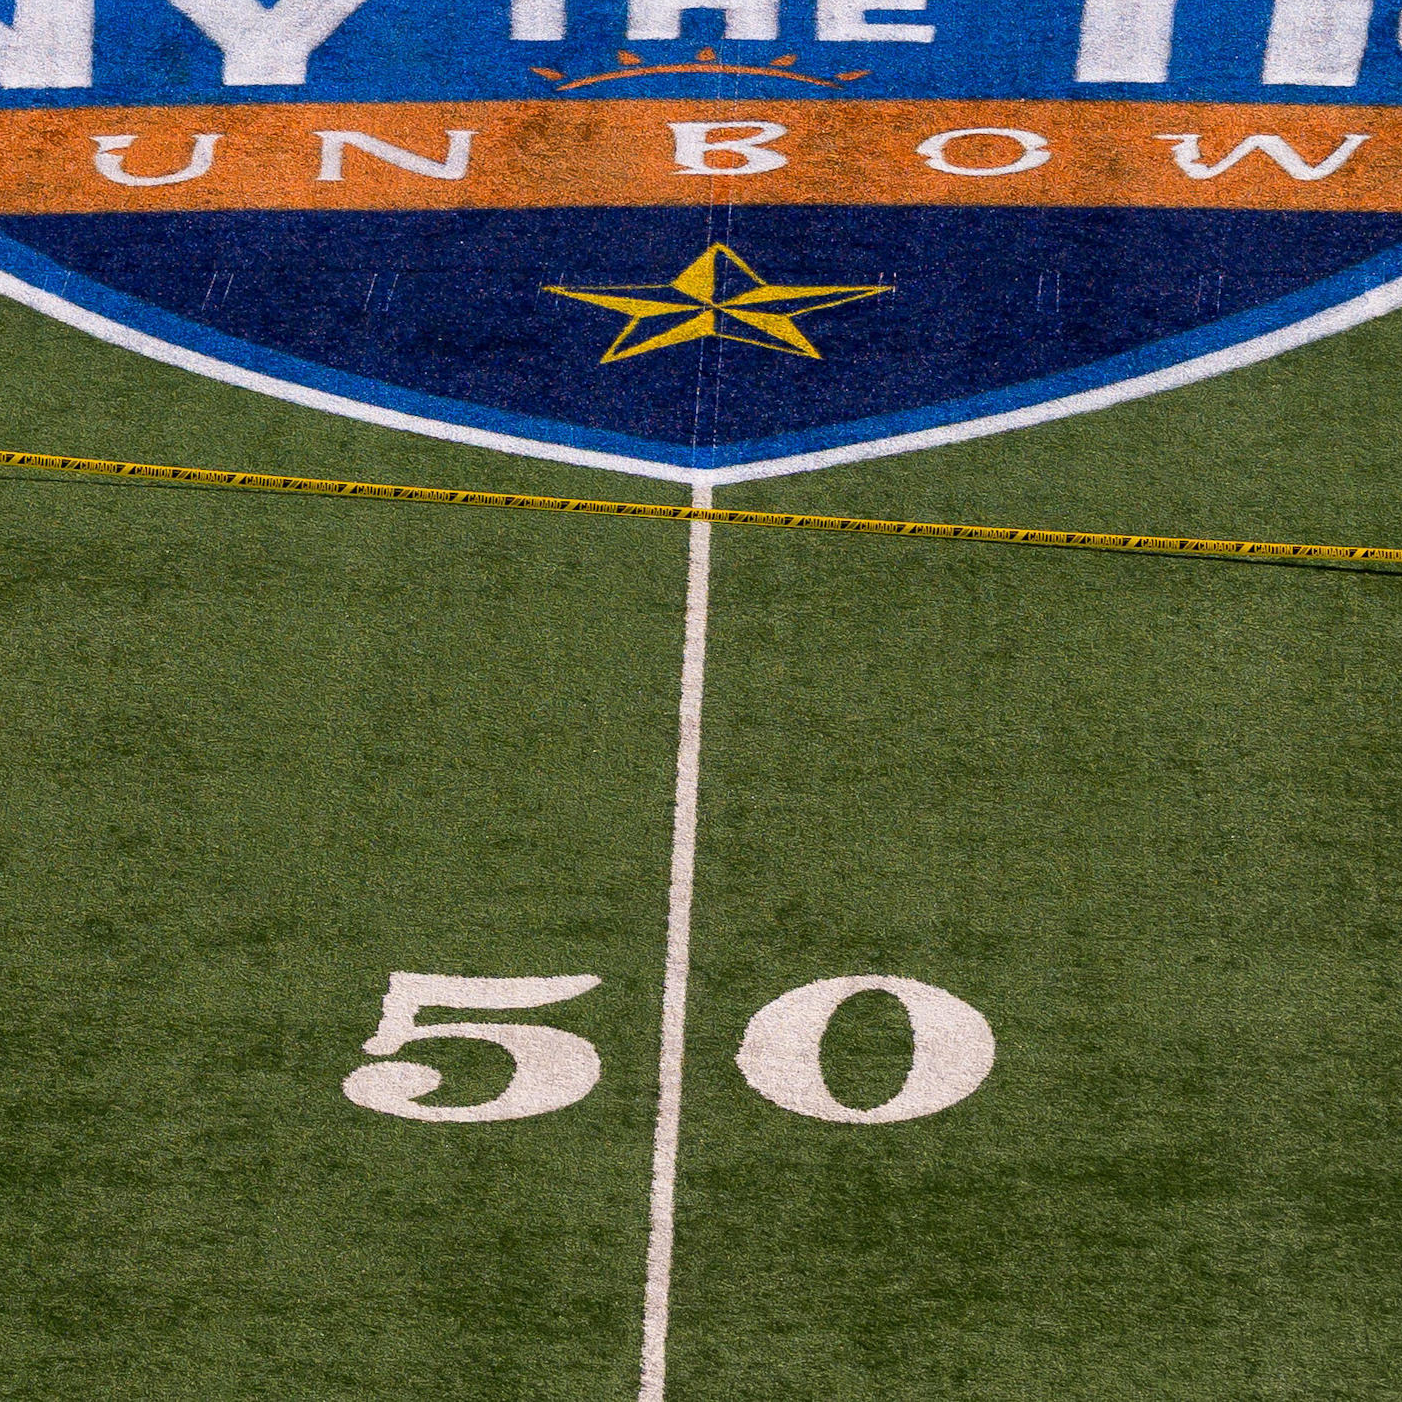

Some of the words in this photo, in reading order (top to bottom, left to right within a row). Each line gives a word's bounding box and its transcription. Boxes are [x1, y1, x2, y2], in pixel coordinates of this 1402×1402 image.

[24, 455, 62, 468] CAUTION
[79, 461, 117, 473] CUIDADO
[134, 466, 172, 478] CAUTION
[190, 471, 227, 483] CUIDADO
[244, 475, 283, 488] CAUTION
[301, 480, 339, 492] CUIDADO
[356, 485, 394, 496] CAUTION
[412, 489, 449, 501] CUIDADO
[467, 493, 505, 505] CAUTION
[523, 498, 561, 509] CUIDADO
[578, 502, 617, 513] CAUTION
[635, 506, 673, 517] CUIDADO
[690, 510, 728, 521] CAUTION
[747, 514, 785, 525] CUIDADO
[802, 517, 840, 529] CAUTION
[859, 521, 897, 533] CUIDADO
[915, 525, 954, 536] CAUTION
[972, 528, 1010, 539] CUIDADO
[1029, 532, 1067, 543] CAUTION
[1085, 535, 1123, 547] CUIDADO
[1141, 538, 1178, 550] CAUTION
[1198, 541, 1236, 553] CUIDADO
[1254, 544, 1293, 556] CAUTION
[1311, 547, 1349, 558] CUIDADO
